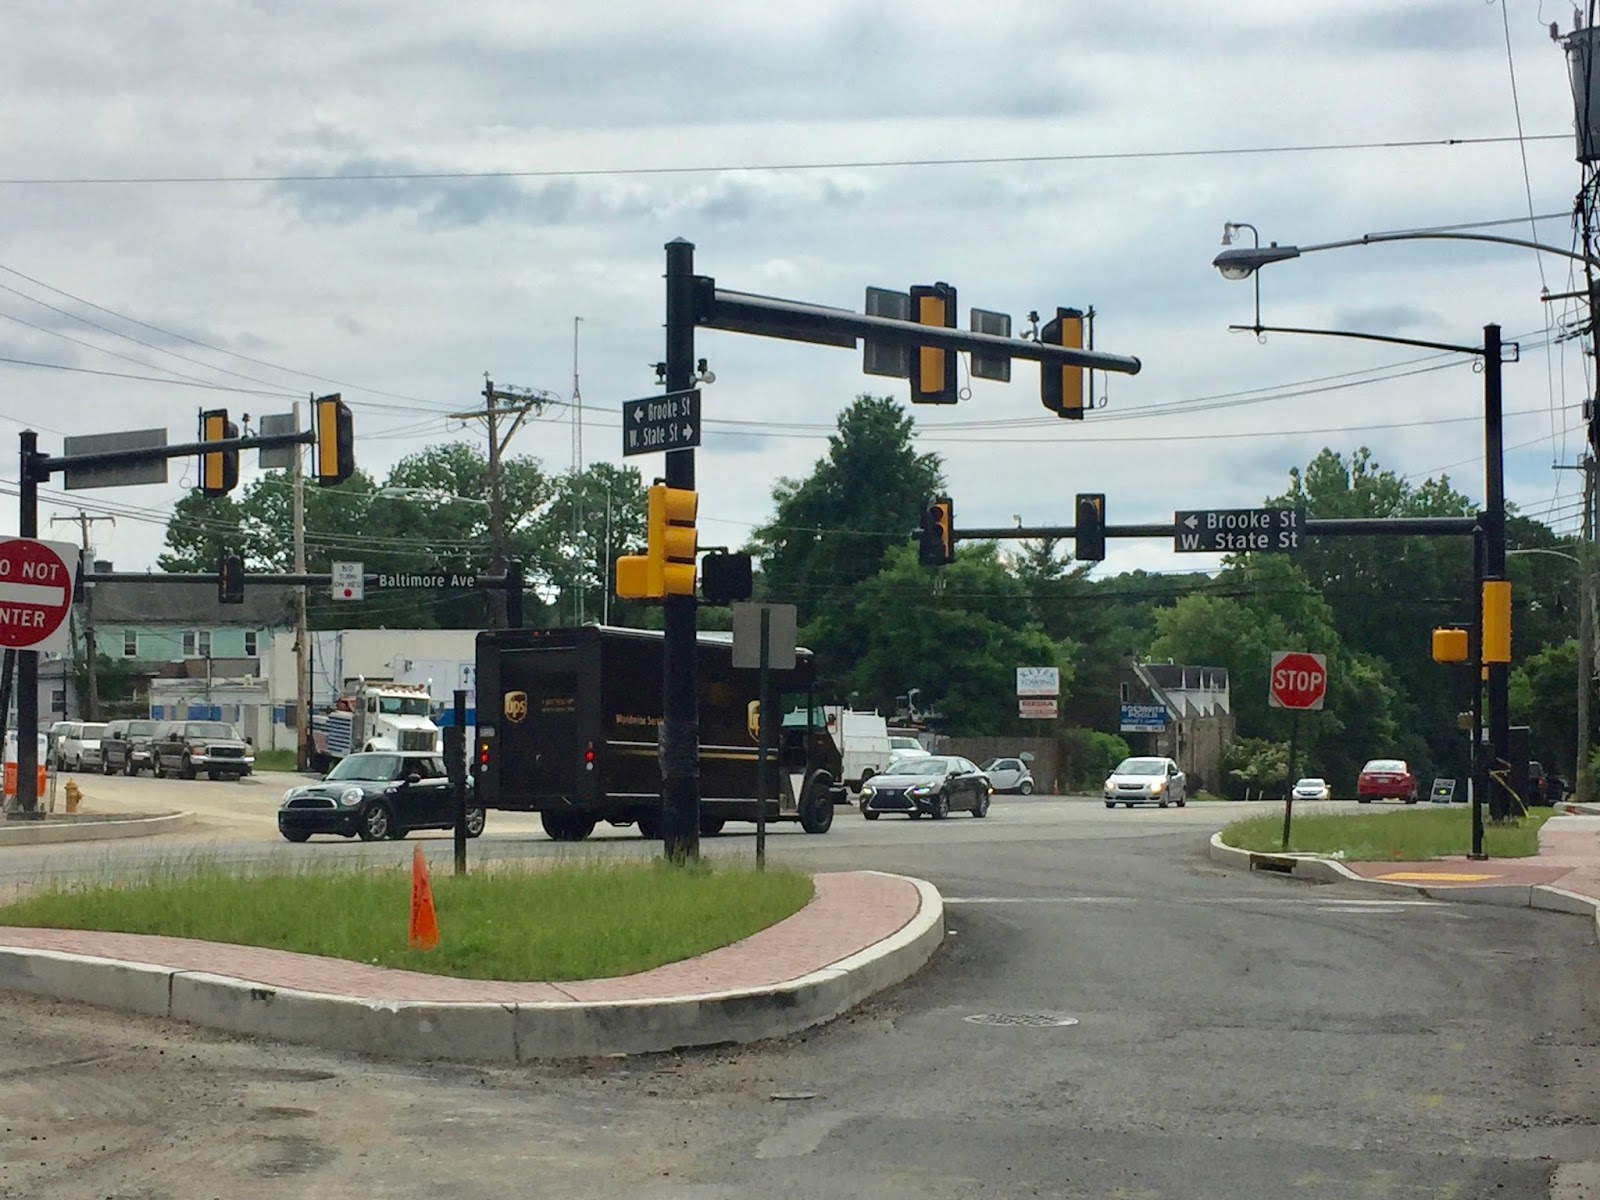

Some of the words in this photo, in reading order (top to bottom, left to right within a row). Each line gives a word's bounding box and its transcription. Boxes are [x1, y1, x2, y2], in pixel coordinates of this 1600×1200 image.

[647, 399, 678, 422] Brooke
[681, 396, 690, 416] St
[629, 429, 640, 448] W.
[643, 426, 665, 446] State
[669, 422, 678, 442] St
[1207, 511, 1270, 529] Brooke
[1280, 511, 1297, 527] St
[1181, 533, 1205, 550] W.
[1215, 532, 1269, 549] State
[1278, 531, 1298, 548] St
[0, 559, 11, 576] O
[22, 561, 60, 581] NOT
[341, 564, 354, 572] NO
[379, 573, 445, 588] Baltimore
[450, 574, 475, 588] Ave
[0, 607, 46, 628] NTER
[1274, 669, 1323, 692] STOP
